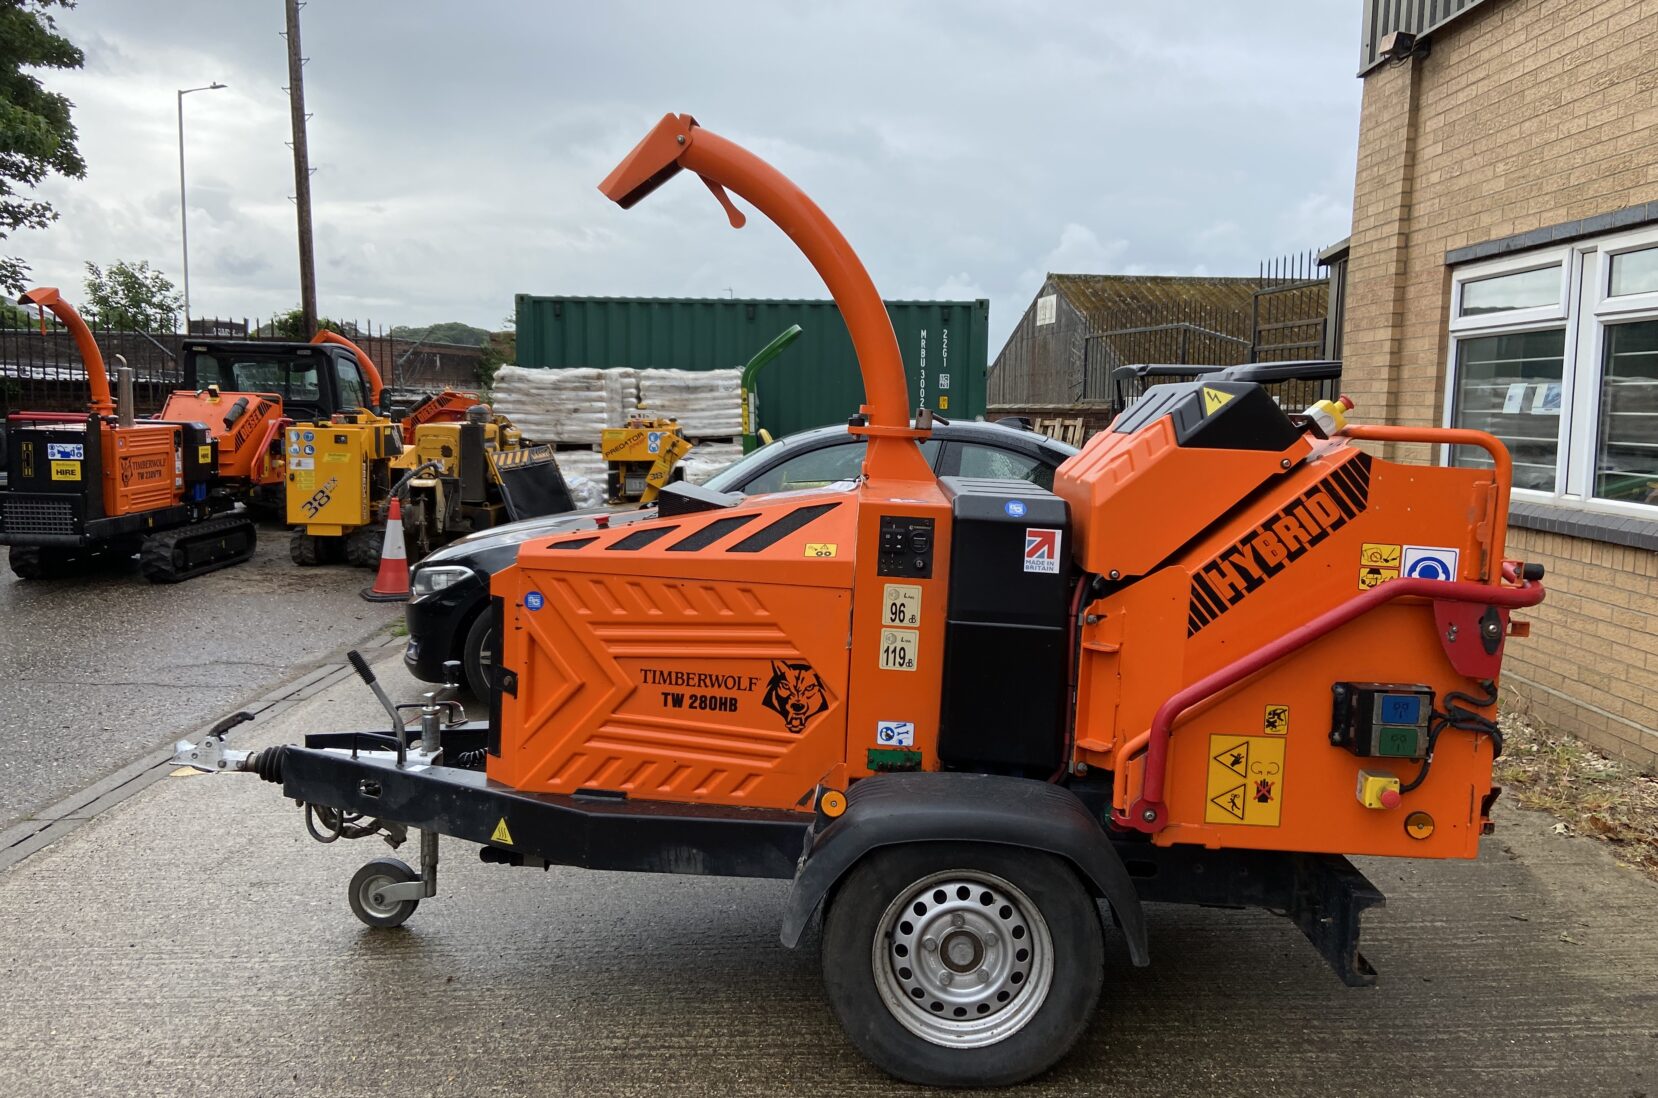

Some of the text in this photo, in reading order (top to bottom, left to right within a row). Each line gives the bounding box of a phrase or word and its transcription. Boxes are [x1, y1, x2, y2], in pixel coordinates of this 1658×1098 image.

[241, 410, 260, 438] DIESEL
[605, 431, 644, 457] PREDATOR
[1205, 489, 1343, 603] HYBRID
[890, 602, 906, 623] 96
[884, 645, 906, 667] 119
[640, 668, 759, 692] TIMBERWOLF
[661, 692, 738, 712] TW 280HB
